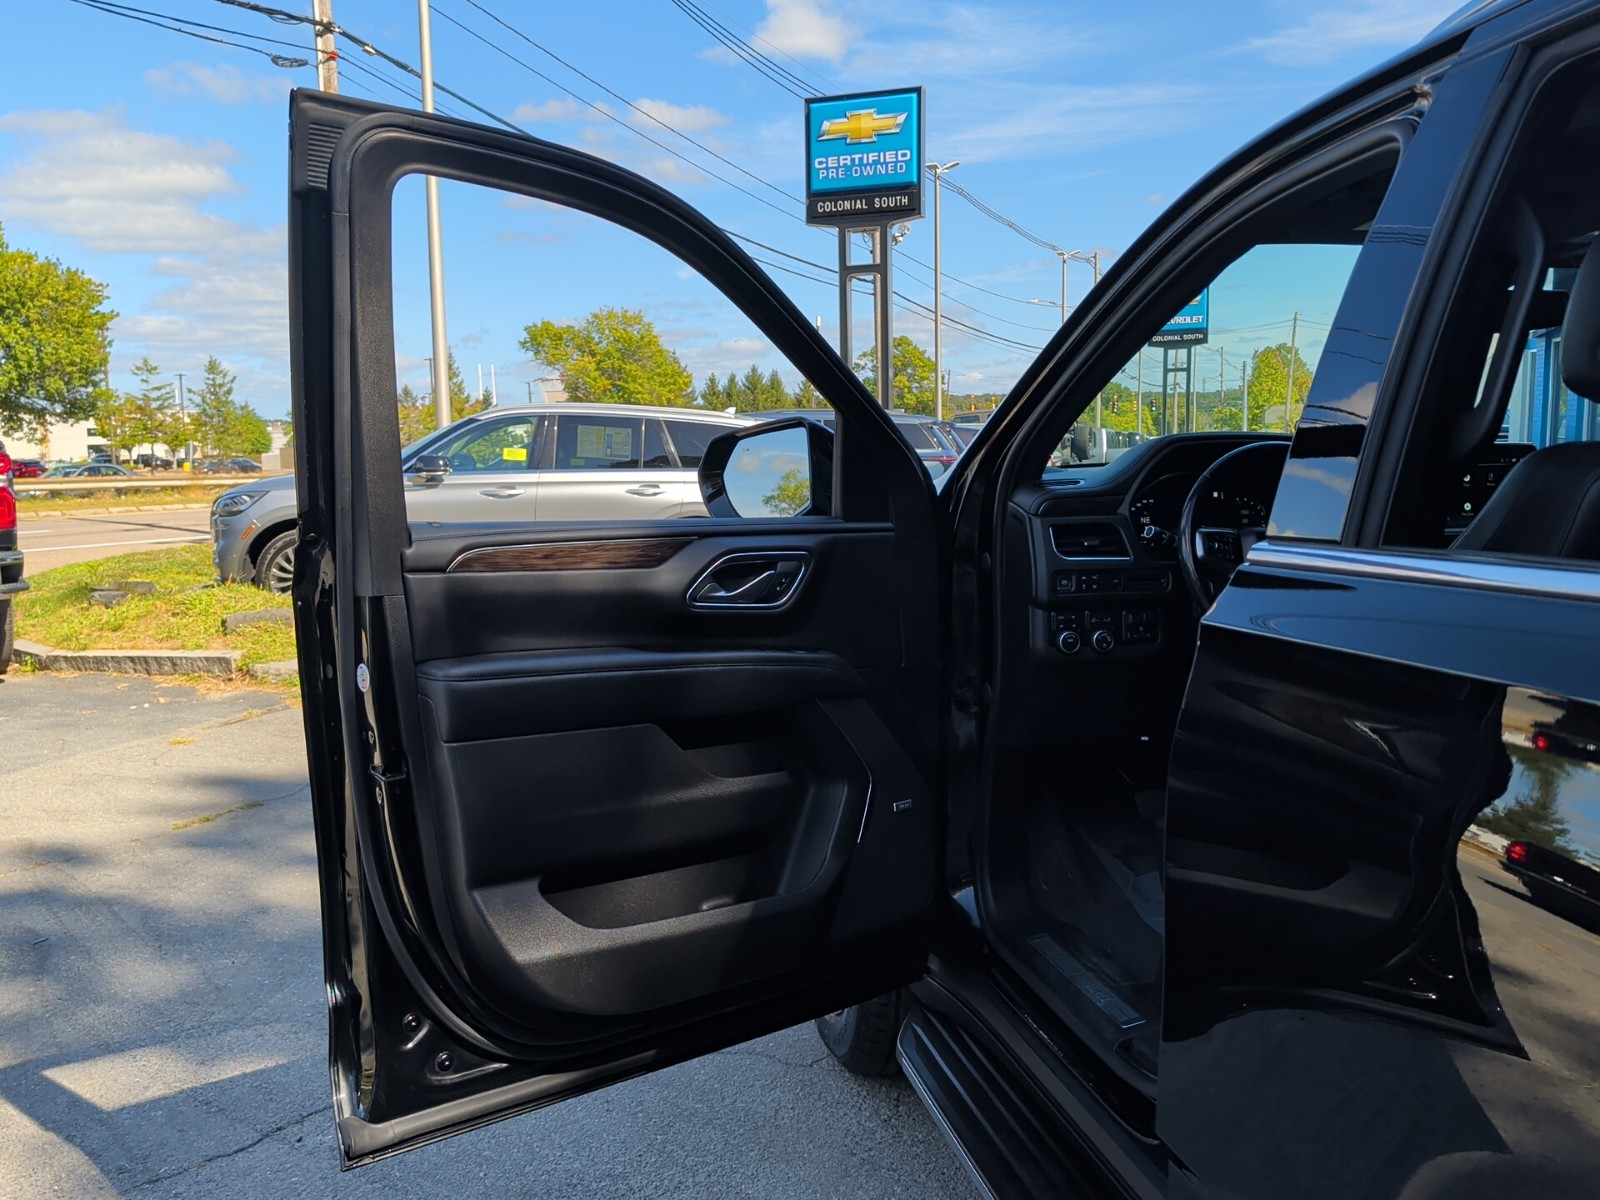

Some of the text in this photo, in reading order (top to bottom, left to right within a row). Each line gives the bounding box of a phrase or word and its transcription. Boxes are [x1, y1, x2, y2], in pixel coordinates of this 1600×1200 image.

[814, 150, 911, 169] CERTIFIED
[819, 162, 906, 179] PRE-OWNED
[817, 196, 909, 212] COLONIAL SOUTH
[1167, 315, 1204, 325] VROLET
[1152, 334, 1182, 342] COLONIAL
[1140, 516, 1151, 524] NE
